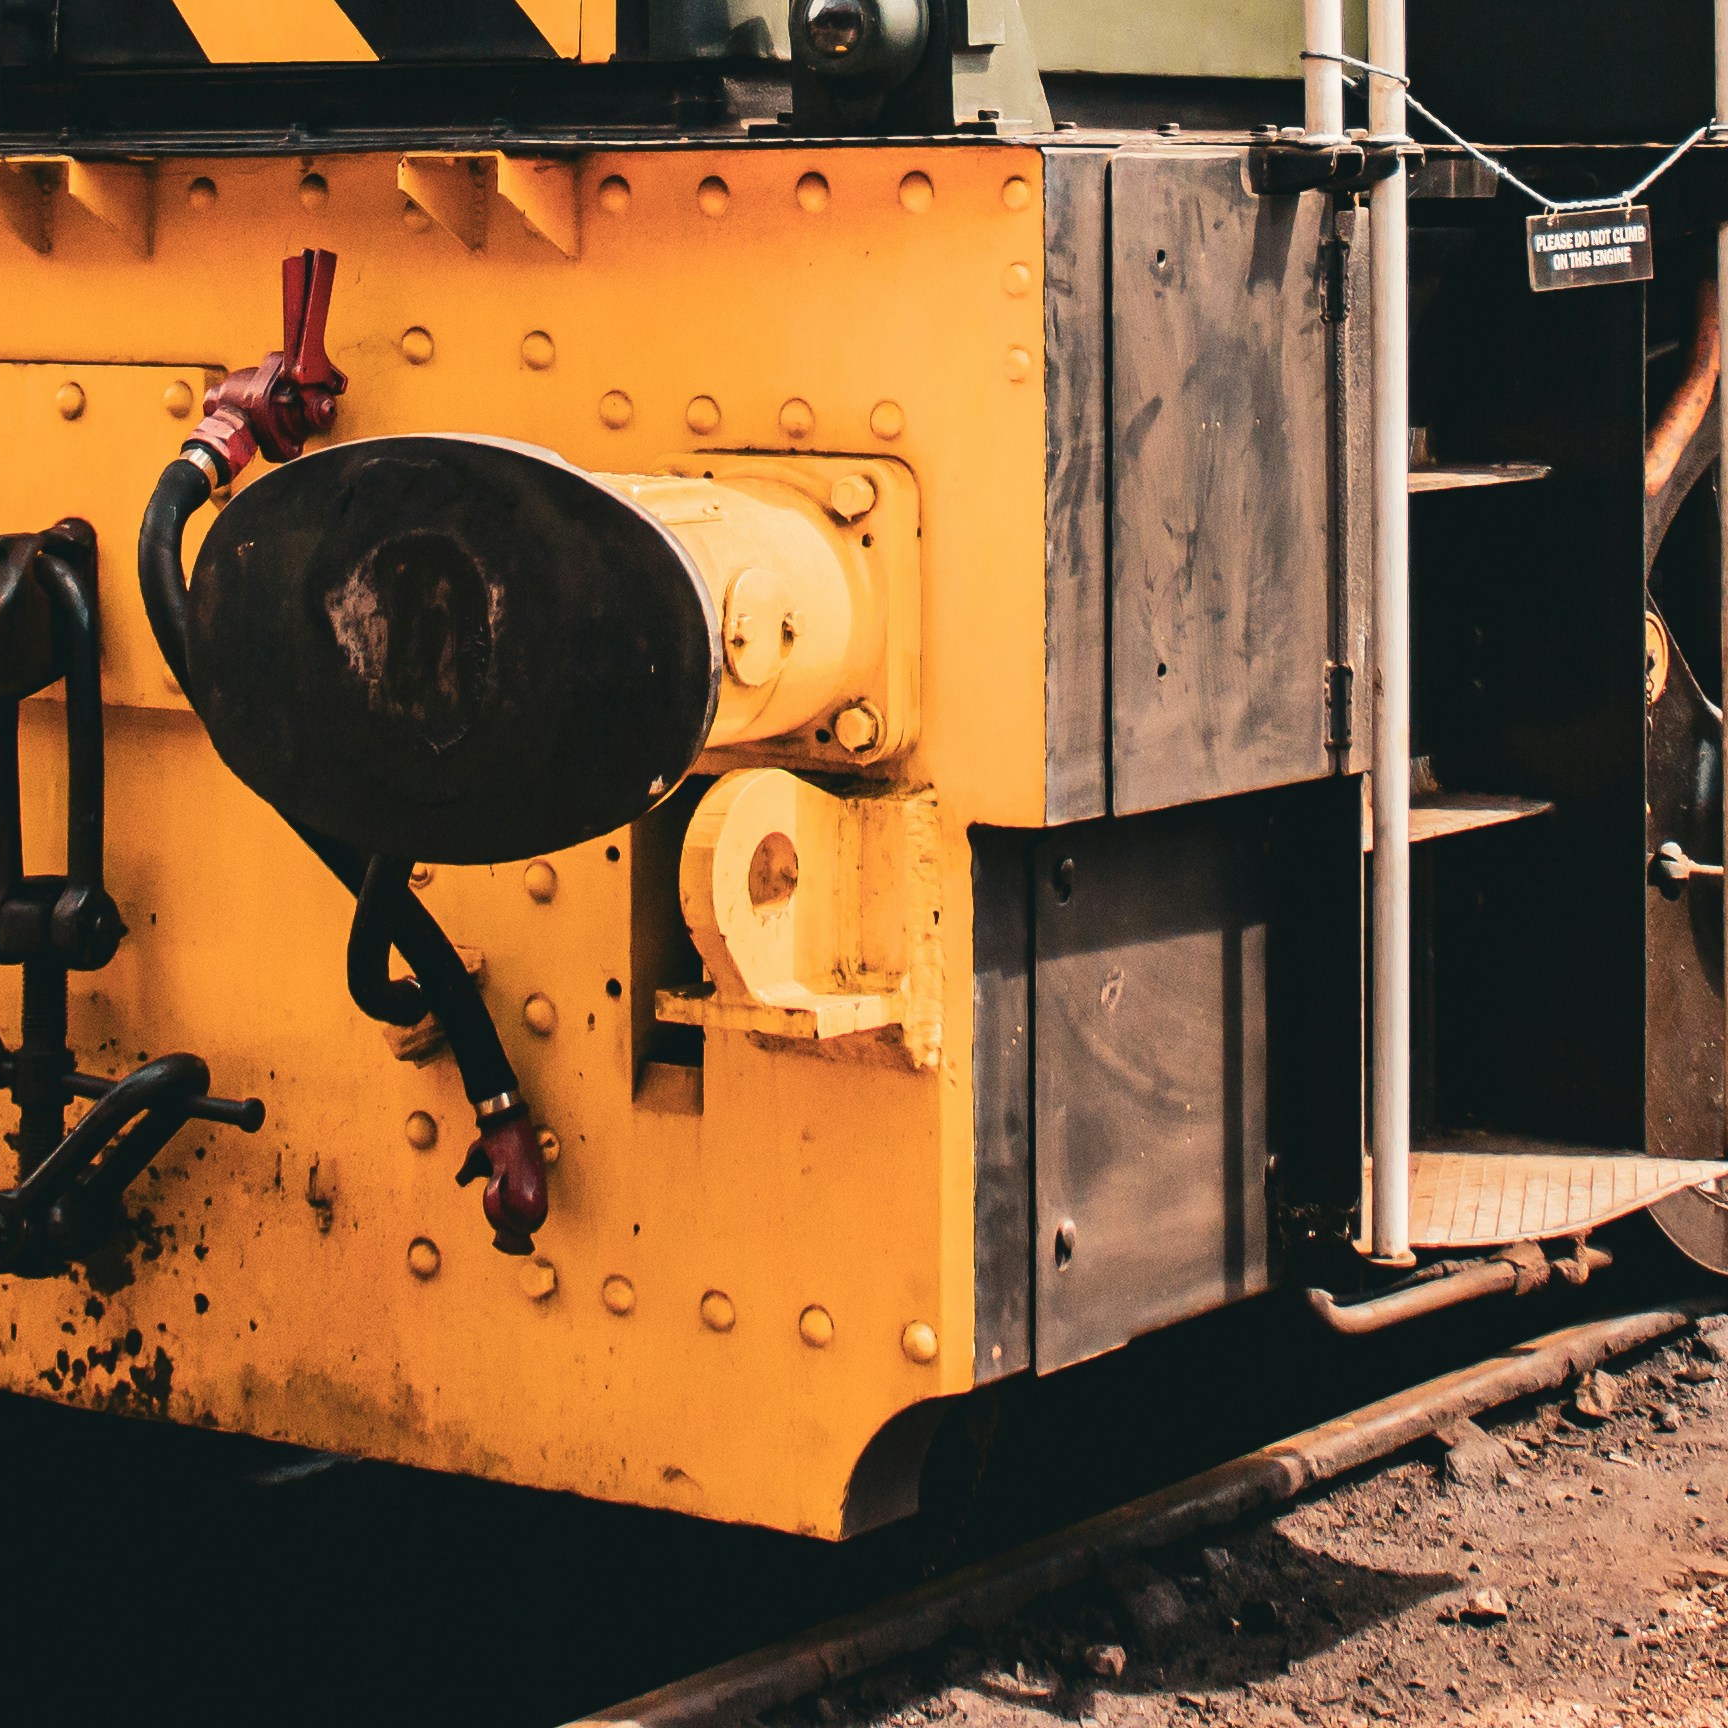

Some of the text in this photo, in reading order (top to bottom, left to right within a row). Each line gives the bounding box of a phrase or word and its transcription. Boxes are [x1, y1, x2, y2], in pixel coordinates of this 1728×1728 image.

[1536, 226, 1647, 251] PLEASE DO NOT CLIMB
[1553, 247, 1632, 270] ON THIS ENGINE
